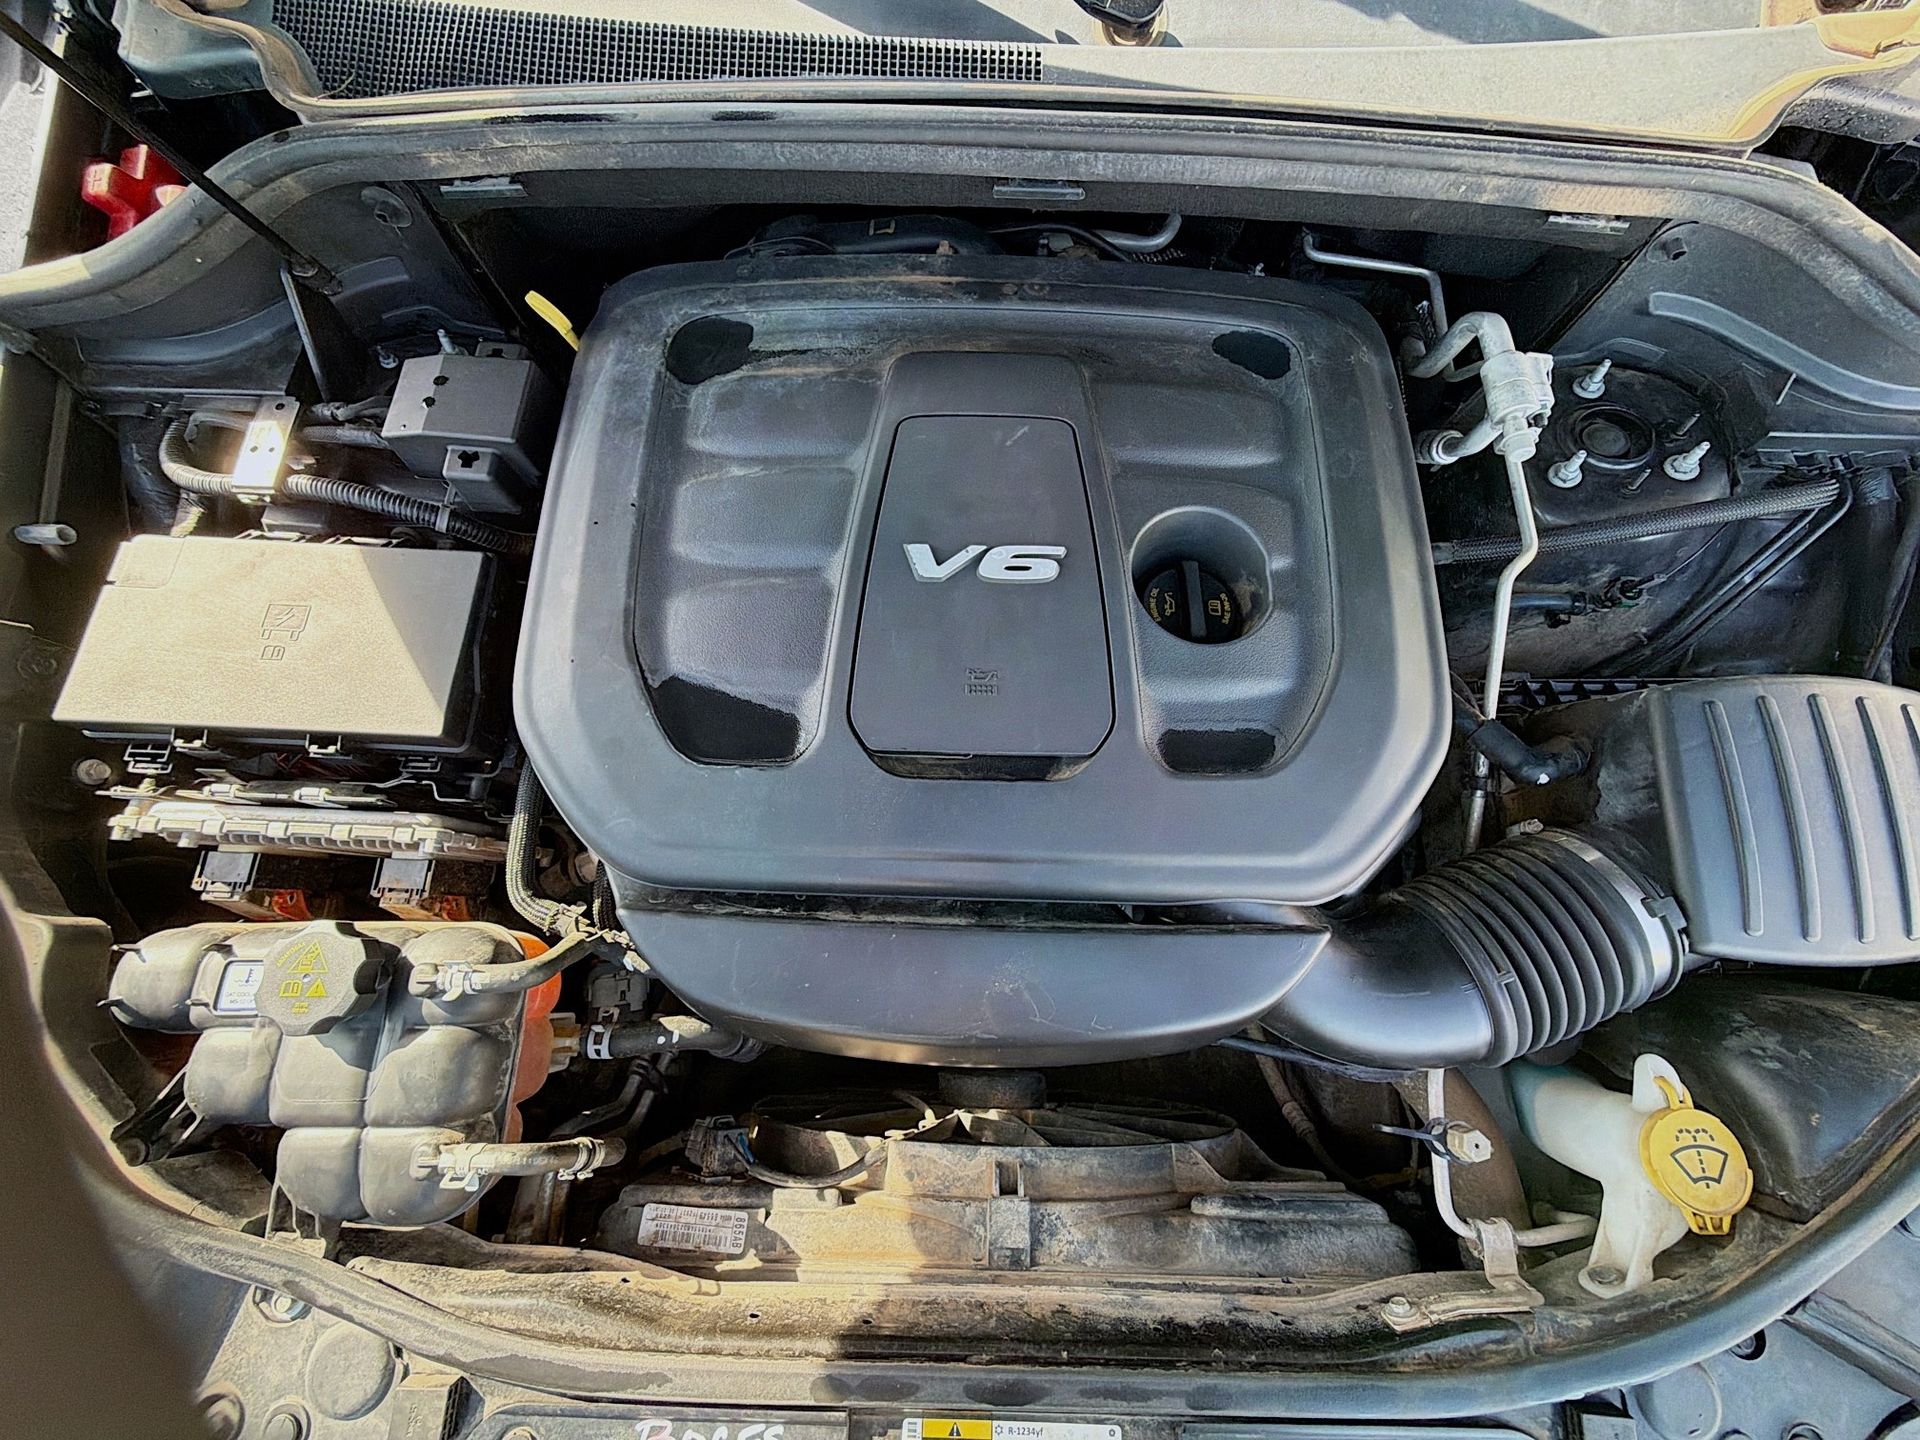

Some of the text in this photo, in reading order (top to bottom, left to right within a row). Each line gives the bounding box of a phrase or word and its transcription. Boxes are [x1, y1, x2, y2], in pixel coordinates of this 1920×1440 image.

[903, 543, 1067, 584] V6
[1149, 588, 1161, 622] ENGINE OIL
[732, 1217, 746, 1249] 865AB
[1007, 1426, 1044, 1438] R-1234yf
